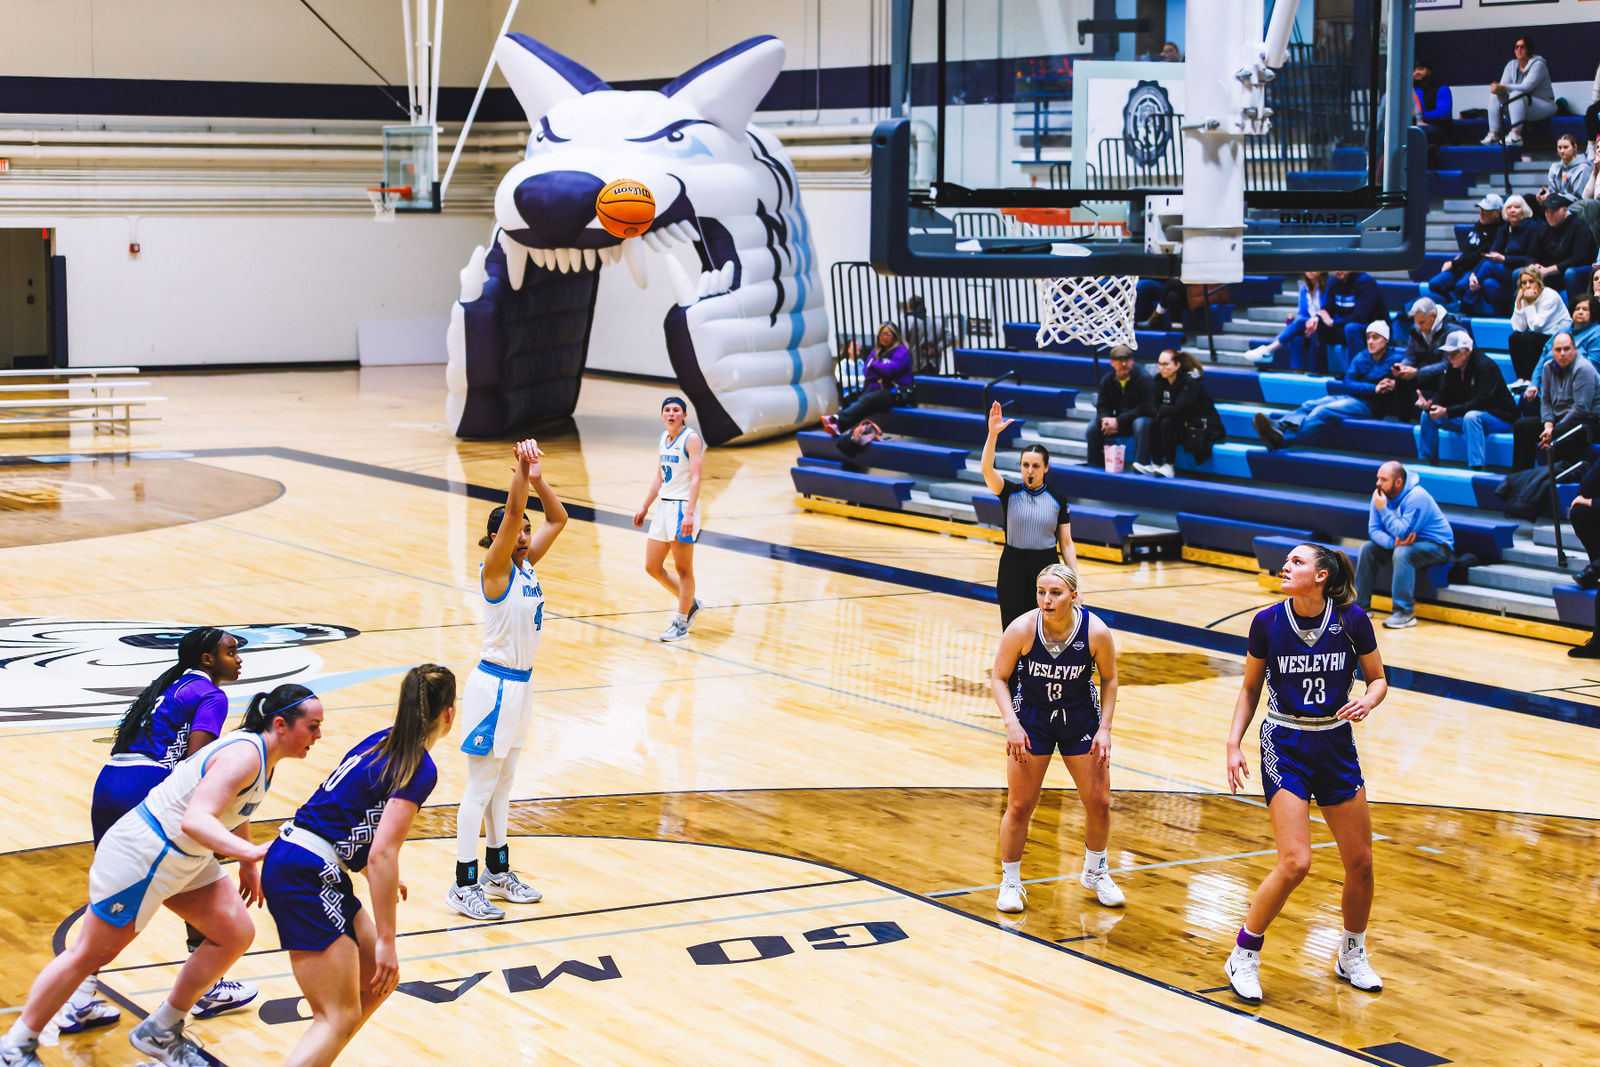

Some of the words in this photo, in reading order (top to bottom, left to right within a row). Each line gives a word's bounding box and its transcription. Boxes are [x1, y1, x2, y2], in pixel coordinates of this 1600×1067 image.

[613, 186, 652, 200] Wilson
[1277, 652, 1347, 674] WESLEYAN
[1045, 682, 1063, 702] 13
[1302, 677, 1326, 705] 23
[686, 921, 910, 966] GO
